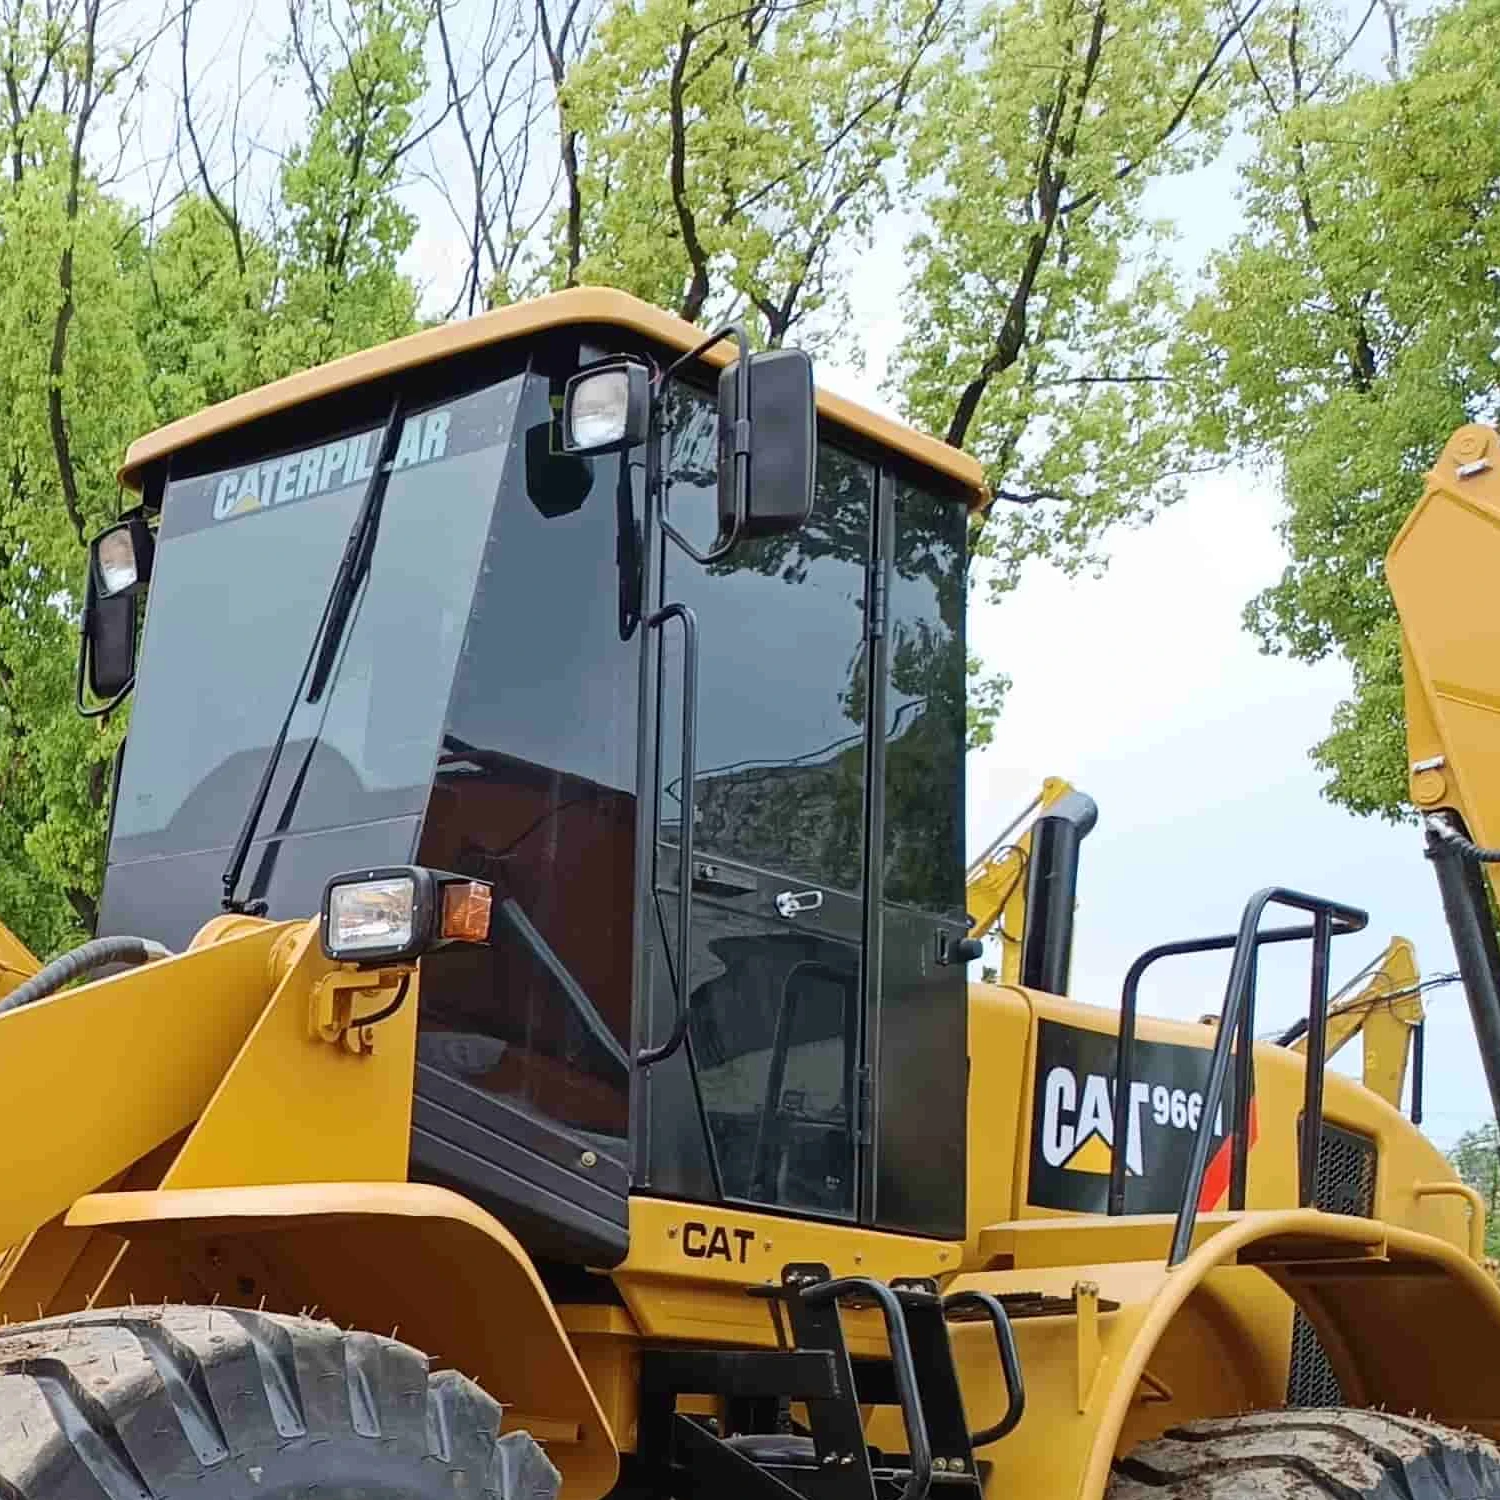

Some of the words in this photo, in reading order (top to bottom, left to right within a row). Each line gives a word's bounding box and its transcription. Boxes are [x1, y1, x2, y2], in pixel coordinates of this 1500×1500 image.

[212, 411, 451, 520] CATERPILAR
[1043, 1067, 1149, 1176] CAT
[1152, 1086, 1222, 1136] 966
[682, 1223, 755, 1264] CAT
